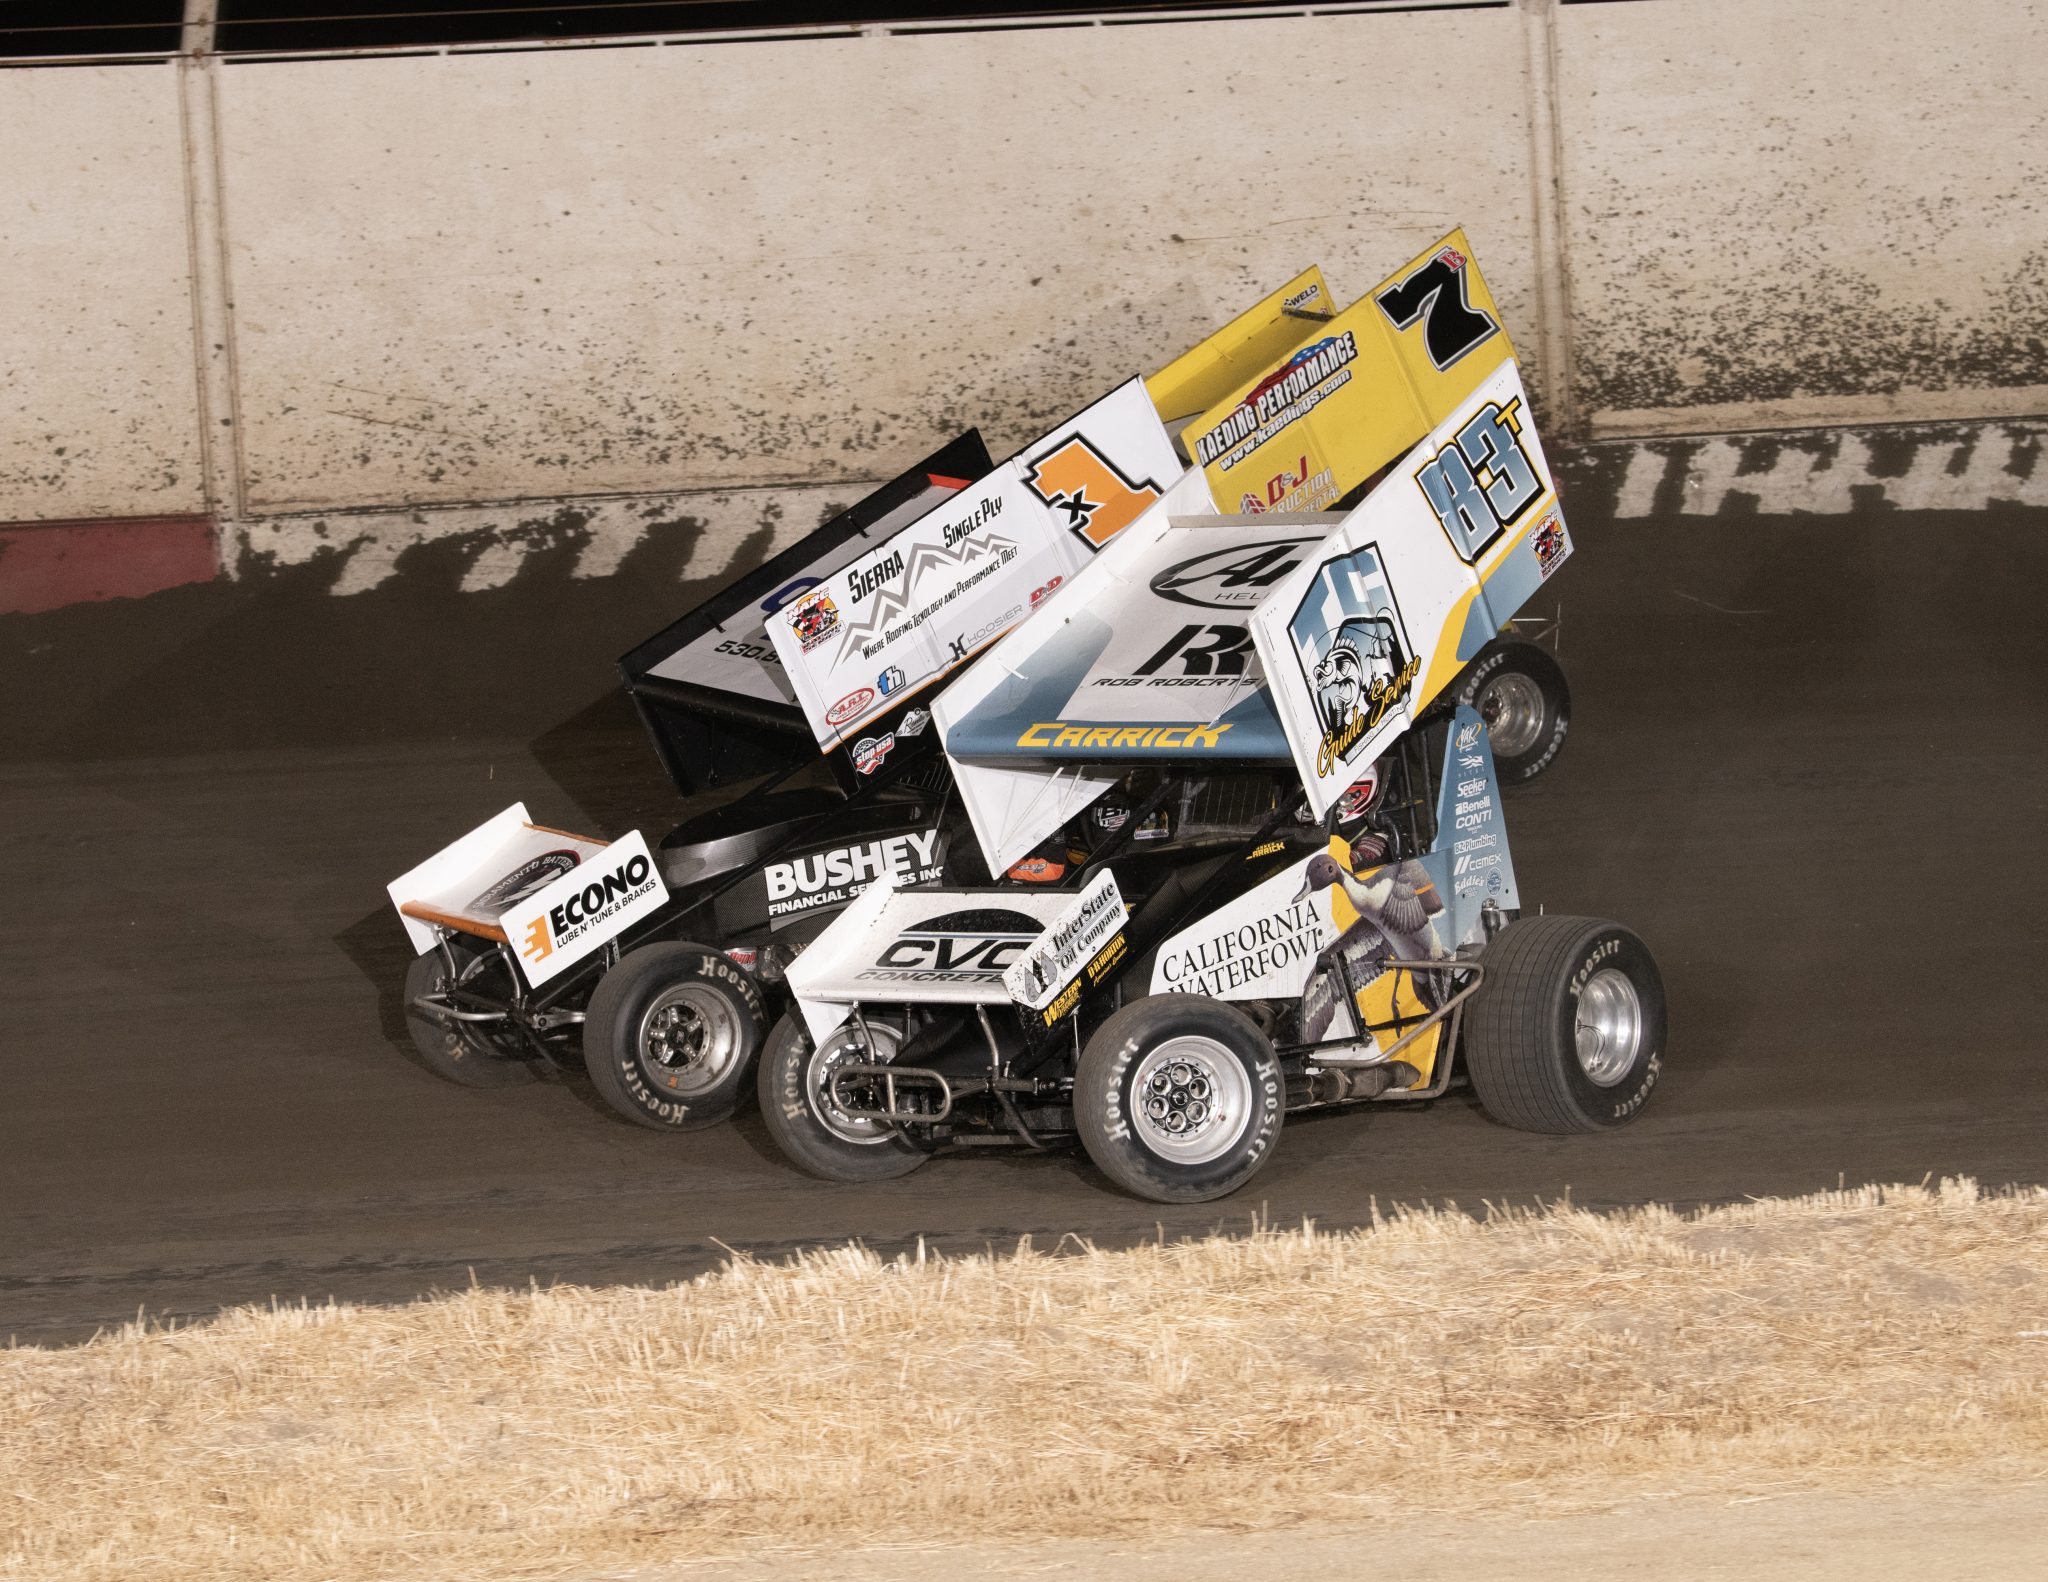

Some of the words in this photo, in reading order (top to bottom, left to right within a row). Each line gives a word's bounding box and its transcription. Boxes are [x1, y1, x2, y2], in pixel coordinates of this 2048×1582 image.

[1290, 284, 1318, 306] WELD
[1195, 403, 1259, 468] KAEDING
[1257, 331, 1358, 423] PERFORMANCE
[1219, 369, 1352, 471] www.kaedings.com
[943, 509, 982, 549] SINGLE
[980, 496, 1003, 523] PLY
[848, 549, 905, 604] SIERRA
[862, 639, 886, 661] WHERE
[885, 619, 914, 645] ROOFING
[944, 588, 957, 605] AND
[956, 557, 1001, 600] PERFORMANCE
[1000, 545, 1018, 565] MEET
[967, 604, 1024, 645] HOOSIER
[1092, 678, 1144, 687] ROB
[1370, 655, 1422, 728] Service
[1016, 723, 1234, 748] CARRICK
[1317, 705, 1366, 778] Guide
[1353, 730, 1375, 753] FISHING
[1524, 716, 1568, 777] Hoosier
[1456, 809, 1492, 829] CONTI
[1457, 778, 1487, 797] Seeker
[1461, 795, 1491, 814] Benelli
[542, 855, 574, 871] BATTERY
[764, 829, 938, 901] BUSHEY
[1469, 854, 1502, 871] CEMEX
[550, 854, 650, 938] ECONO
[556, 929, 580, 949] LUBE
[588, 907, 614, 928] TUNE
[614, 901, 622, 912] &
[622, 879, 657, 906] BRAKES
[768, 889, 847, 916] FINANCIAL
[849, 873, 917, 898] SEES
[1051, 882, 1116, 951] InterState
[1060, 946, 1078, 970] Oil
[1078, 900, 1122, 953] Company
[1163, 899, 1321, 983] CALIFORNIA
[697, 954, 764, 1021] Hoosier
[853, 971, 1006, 983] CONCRETE
[1042, 976, 1083, 1028] WESTERN
[1569, 939, 1621, 1002] Hoosier
[621, 1059, 691, 1124] Hoosier
[1103, 1037, 1140, 1143] Hoosier
[1247, 1058, 1280, 1164] Hoosier
[1613, 1051, 1662, 1118] Hoosier
